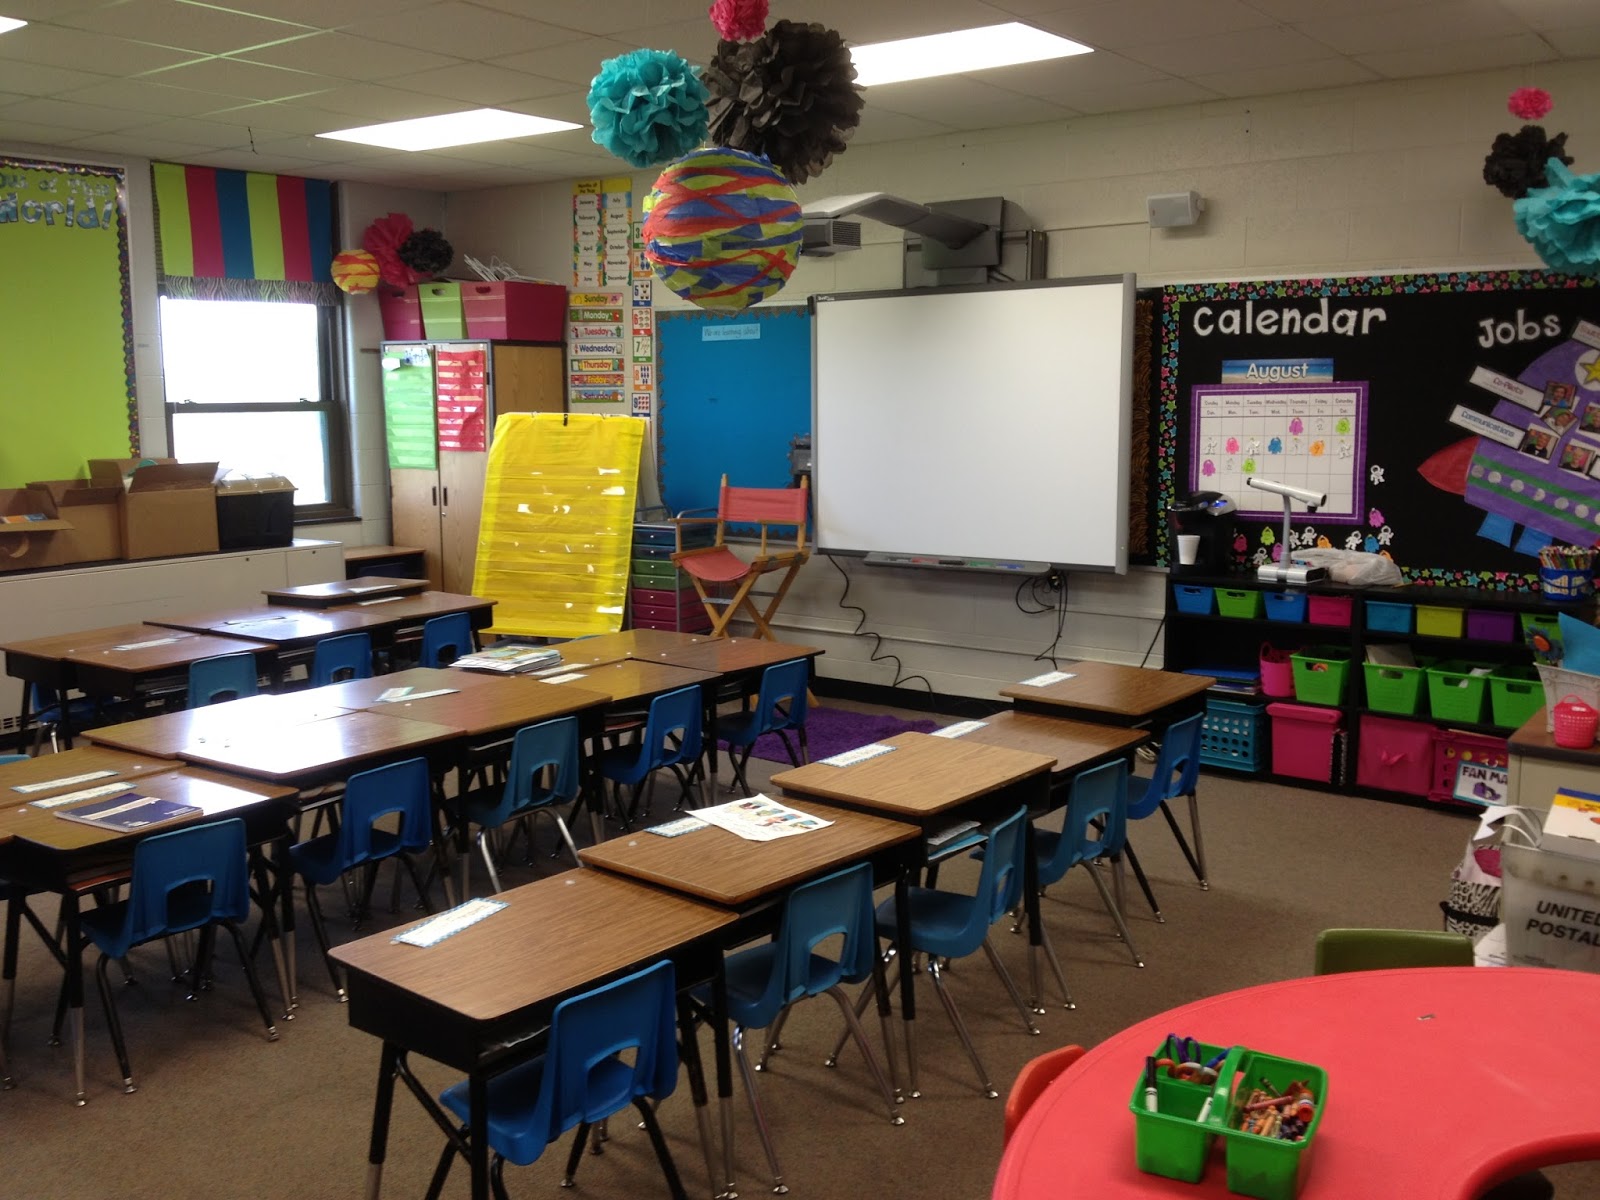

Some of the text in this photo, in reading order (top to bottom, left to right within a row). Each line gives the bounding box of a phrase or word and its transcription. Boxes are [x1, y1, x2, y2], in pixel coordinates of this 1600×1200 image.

[634, 285, 639, 297] 5
[584, 294, 608, 304] Sunday
[583, 311, 610, 321] Monday
[583, 327, 609, 337] Tuesday
[1478, 308, 1561, 348] Jobs
[579, 344, 616, 353] Wednesday
[635, 341, 641, 353] 7
[583, 360, 612, 370] Thursday
[1246, 362, 1309, 382] August
[587, 376, 607, 385] Friday
[1339, 422, 1347, 431] 3
[1461, 410, 1515, 438] Communications
[1462, 766, 1487, 780] FAN
[1536, 900, 1600, 927] UNITED
[1526, 918, 1600, 947] POSTAL
